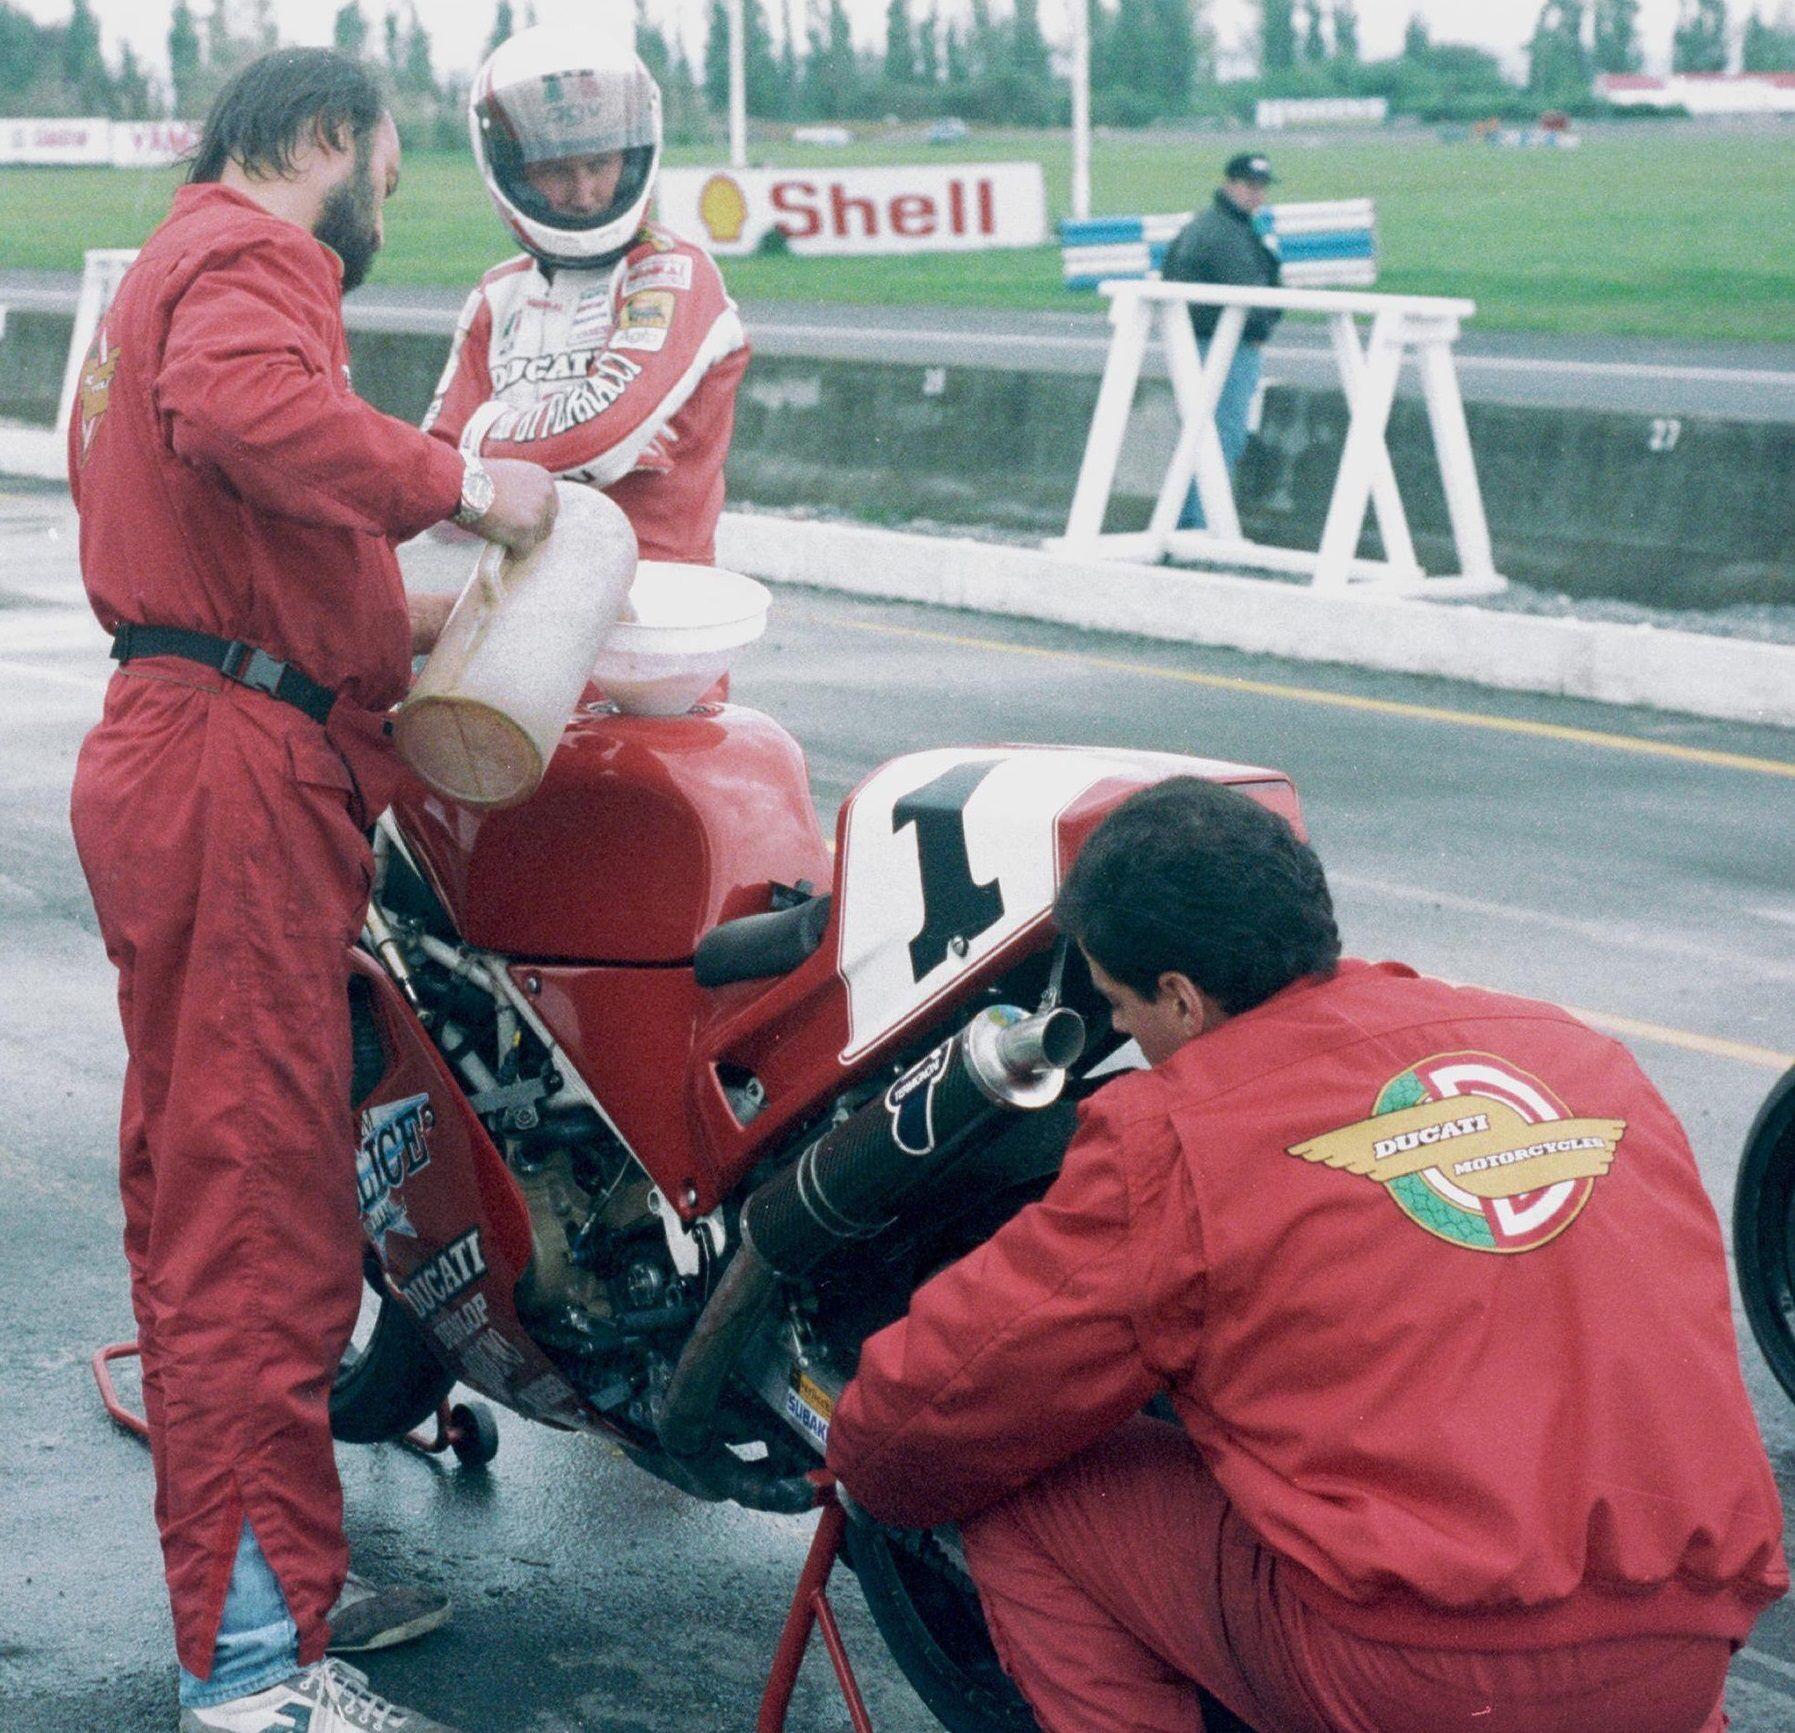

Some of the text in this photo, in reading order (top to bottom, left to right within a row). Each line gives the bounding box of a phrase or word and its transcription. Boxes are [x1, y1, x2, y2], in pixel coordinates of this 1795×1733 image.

[769, 179, 994, 239] Shell
[490, 350, 596, 397] DUCAT
[892, 757, 1008, 984] 1
[1373, 1113, 1490, 1161] DUCATI
[1453, 1136, 1607, 1176] MOTORCYCLES
[402, 1230, 487, 1320] DUCATI
